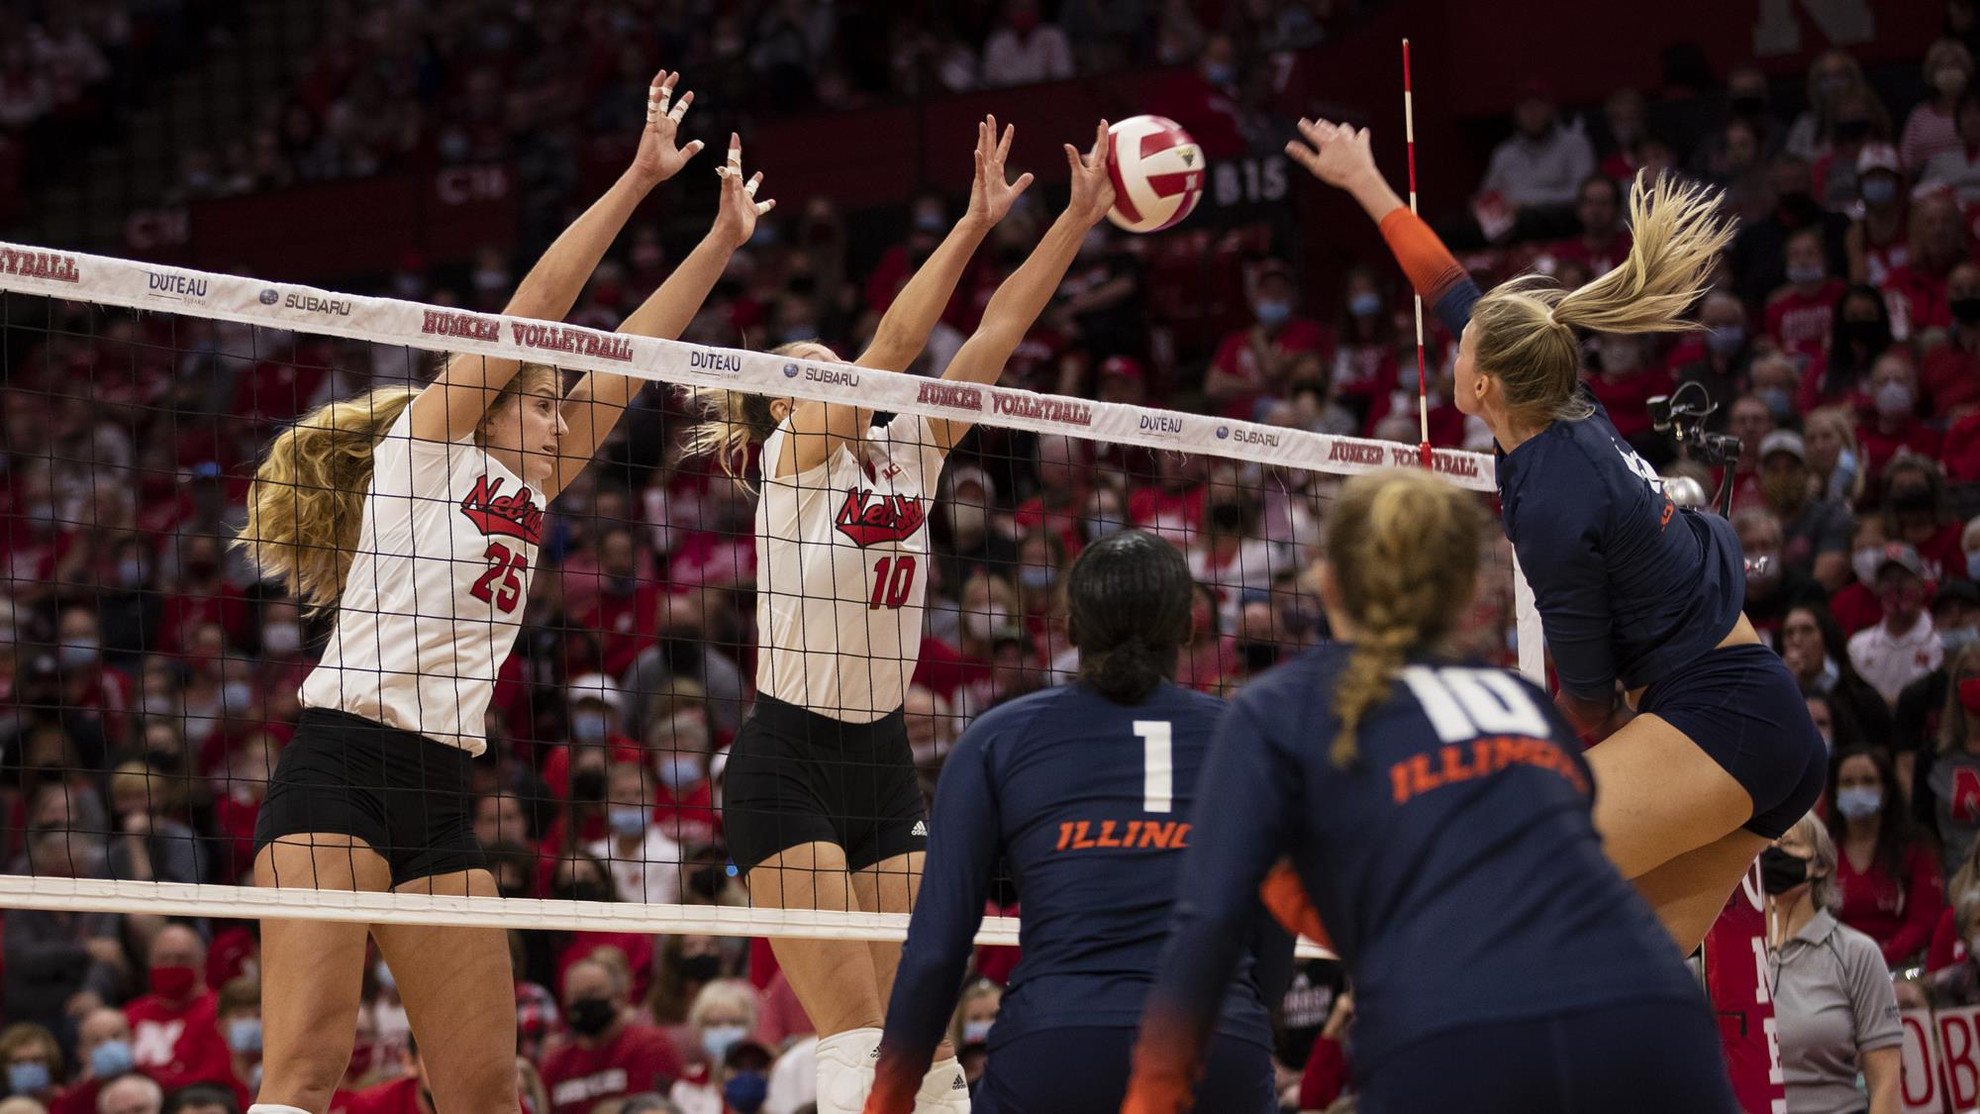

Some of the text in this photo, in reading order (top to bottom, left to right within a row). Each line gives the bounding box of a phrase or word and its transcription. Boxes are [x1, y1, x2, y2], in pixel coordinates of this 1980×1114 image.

[149, 272, 208, 297] DUTEAU
[284, 293, 352, 317] SUBARU
[422, 309, 634, 363] HUSKER VOLLEYBALL
[690, 350, 742, 373] DUTEAU
[805, 366, 860, 388] SUBARU
[916, 381, 1093, 427] HUSKER VOLLEYBALL
[1139, 414, 1183, 433] DUTEAU
[1233, 428, 1280, 447] SUBARU
[1328, 440, 1384, 466] HUSKER
[469, 541, 529, 615] 25
[869, 556, 917, 610] 10
[1398, 663, 1552, 744] 10
[1132, 720, 1173, 813] 1
